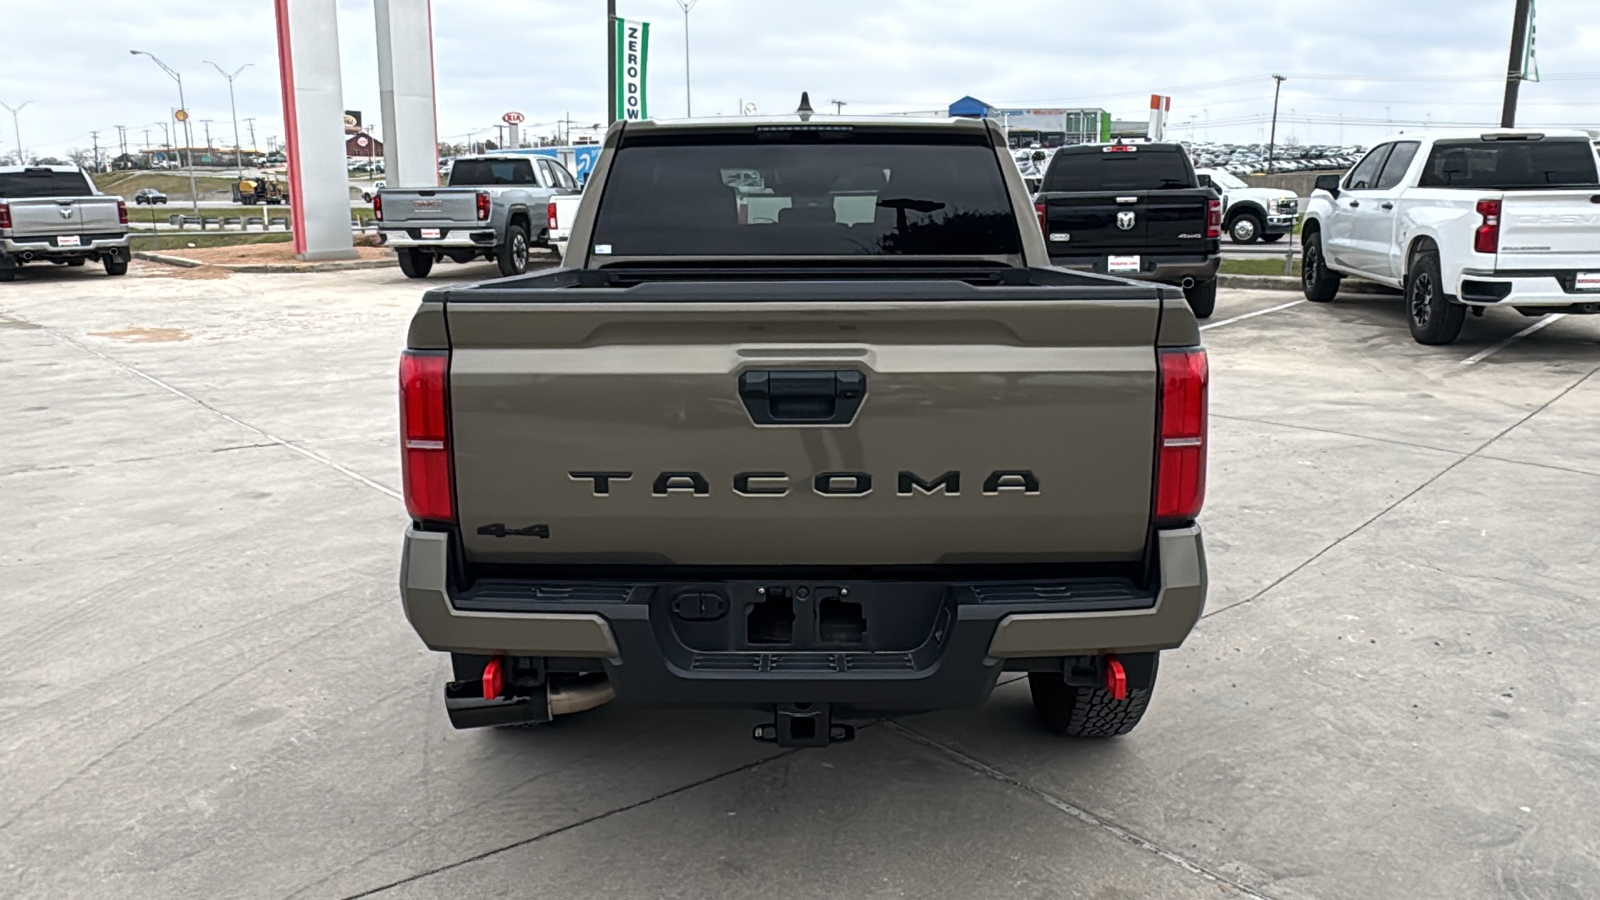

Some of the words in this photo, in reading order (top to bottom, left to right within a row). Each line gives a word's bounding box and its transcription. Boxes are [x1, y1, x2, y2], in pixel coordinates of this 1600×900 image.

[627, 27, 638, 78] ZERO
[626, 82, 639, 120] DOW
[507, 114, 522, 122] KIA
[567, 470, 1041, 498] TACOMA
